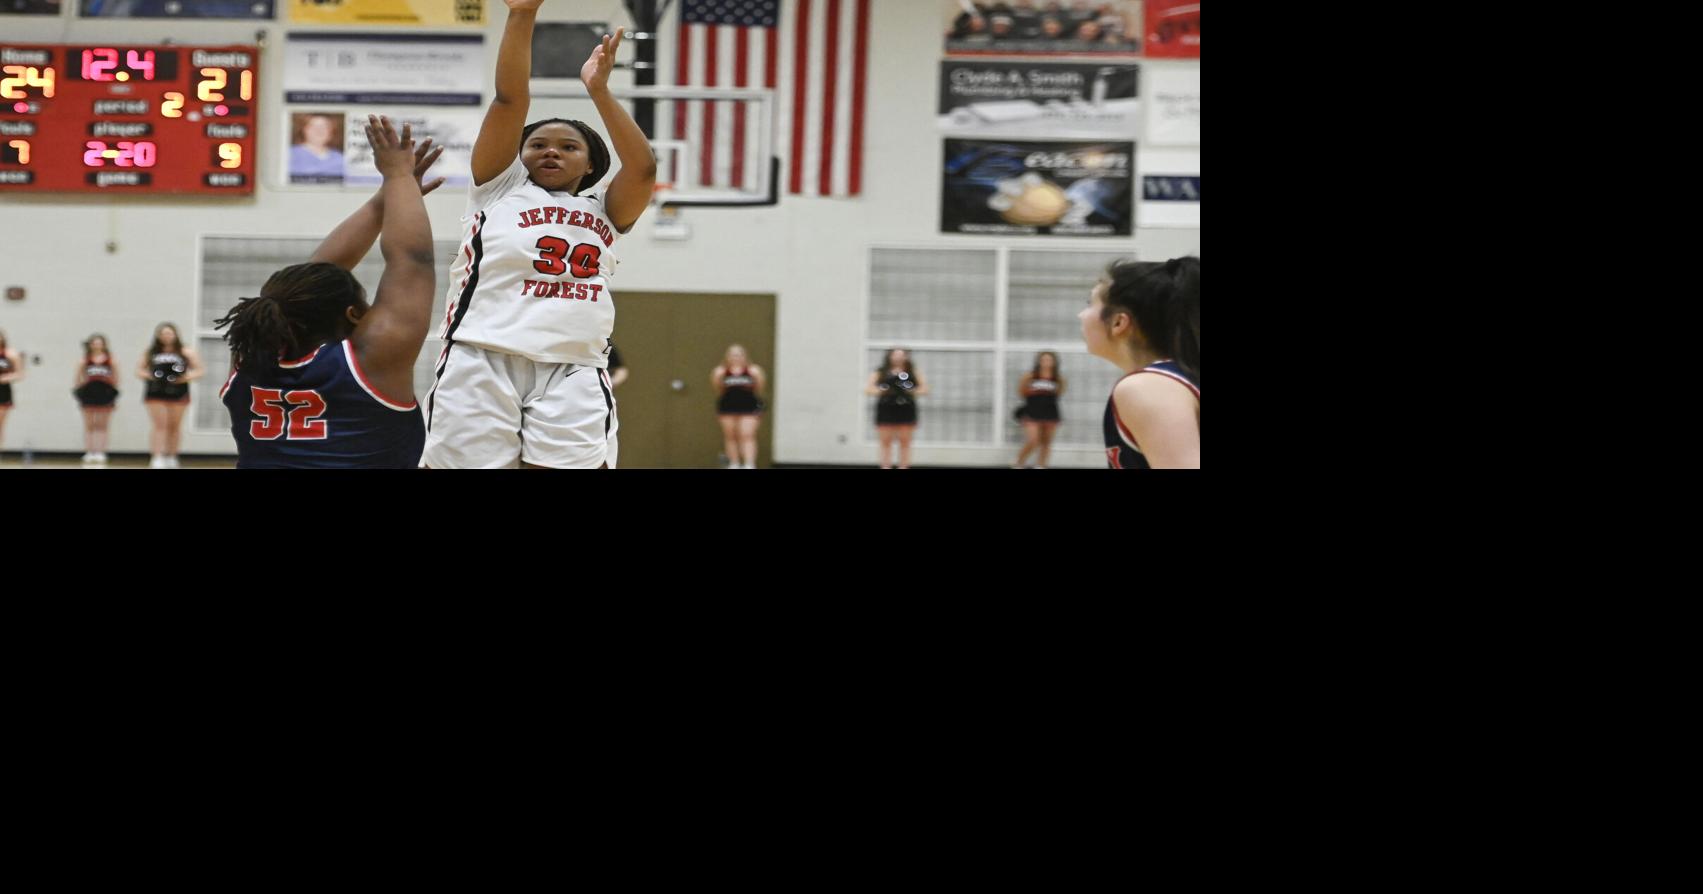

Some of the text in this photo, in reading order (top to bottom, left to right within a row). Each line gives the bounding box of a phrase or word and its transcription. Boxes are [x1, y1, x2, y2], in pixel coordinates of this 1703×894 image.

[1, 49, 46, 63] Home
[82, 48, 155, 81] 12.4
[192, 49, 250, 67] Guests
[1, 65, 55, 98] 24
[198, 68, 252, 101] 21
[1027, 68, 1084, 85] Smith
[94, 100, 148, 115] period
[161, 92, 184, 118] 2
[93, 121, 147, 137] player
[9, 140, 30, 164] 7
[83, 141, 157, 168] 2-20
[218, 142, 242, 168] 9
[96, 170, 139, 187] game
[533, 235, 601, 278] 30
[521, 279, 603, 302] FOREST
[249, 386, 328, 440] 52
